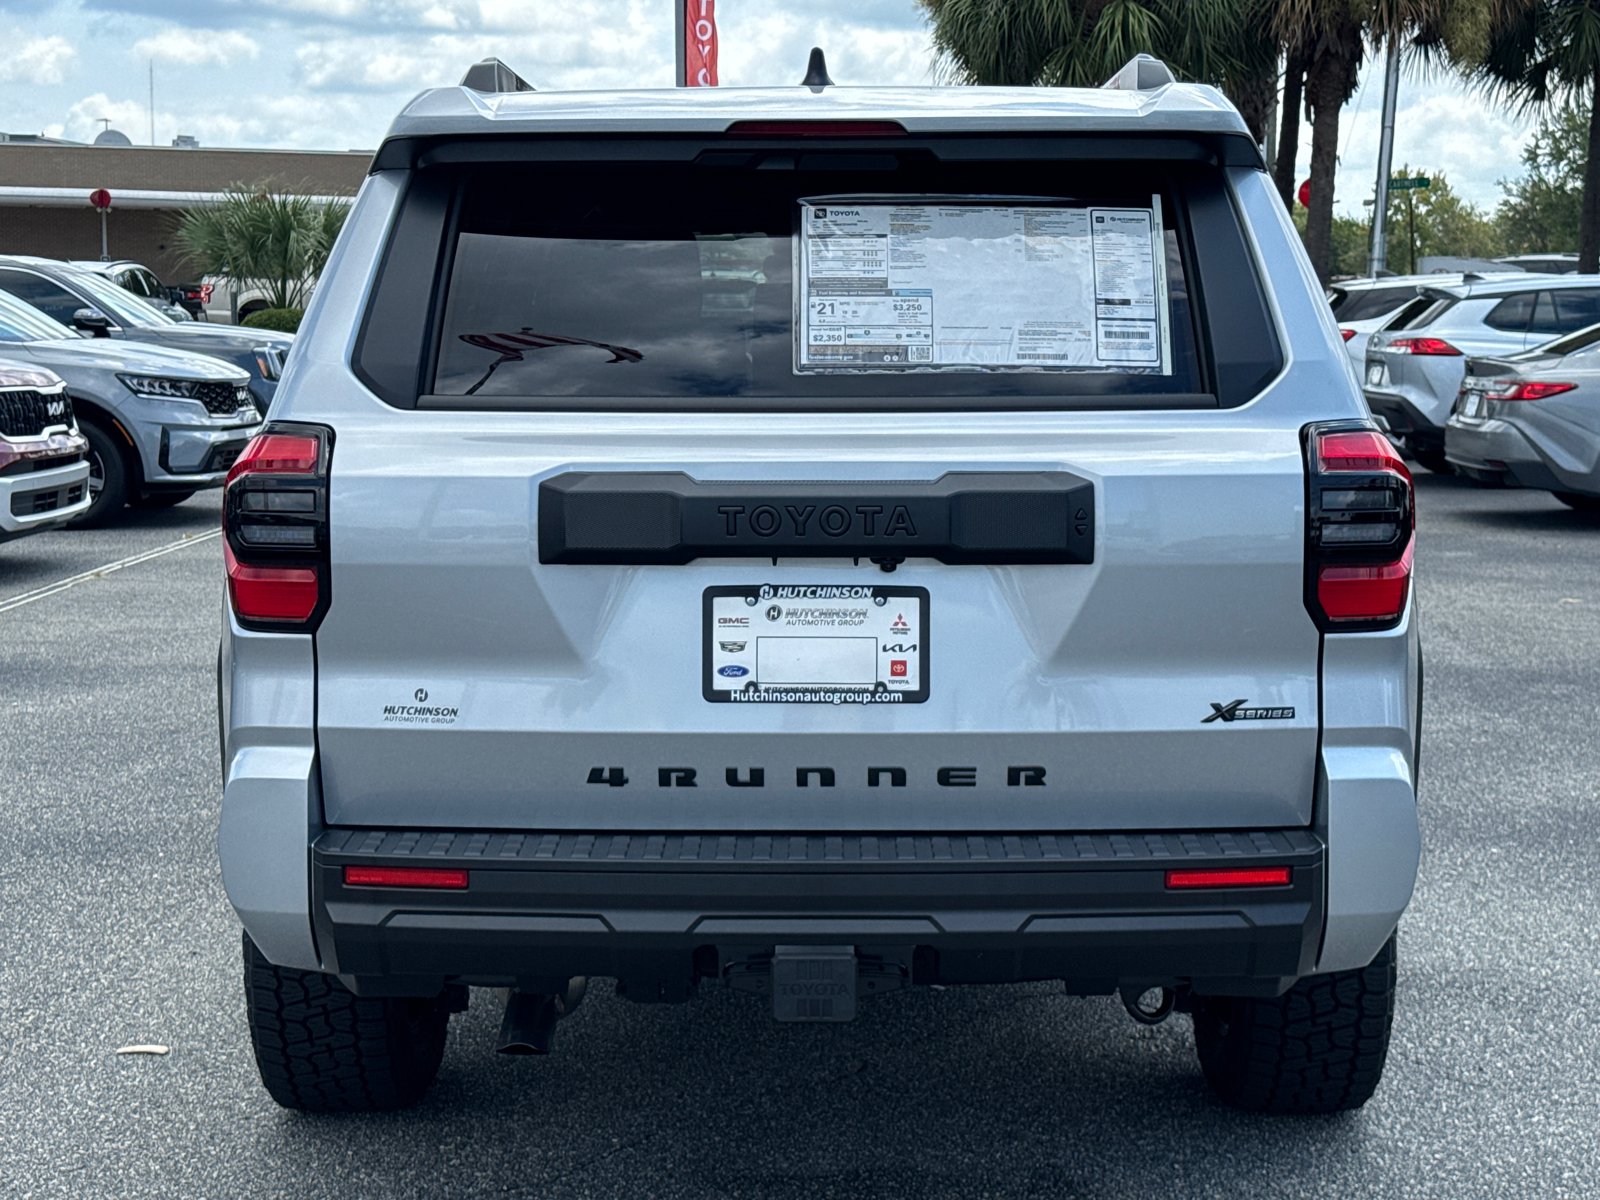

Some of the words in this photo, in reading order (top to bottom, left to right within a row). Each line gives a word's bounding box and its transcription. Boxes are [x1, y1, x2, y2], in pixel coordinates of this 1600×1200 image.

[817, 302, 835, 315] 21
[893, 303, 922, 311] $3,250
[813, 334, 842, 342] $2,350
[717, 505, 918, 538] TOYOTA
[776, 586, 874, 600] HUTCHINSON
[784, 608, 867, 619] HUTCHINSON
[882, 643, 918, 653] KIA
[723, 667, 743, 676] Ford
[730, 689, 904, 705] Hutchinsonautogroup.com
[383, 705, 459, 717] HUTCHINSON
[1234, 709, 1293, 719] SERIES
[383, 715, 430, 724] AUTOMOTIVE
[431, 717, 456, 725] GROUP
[586, 766, 1047, 788] 4RUNNER
[780, 983, 850, 996] TOYOTA
